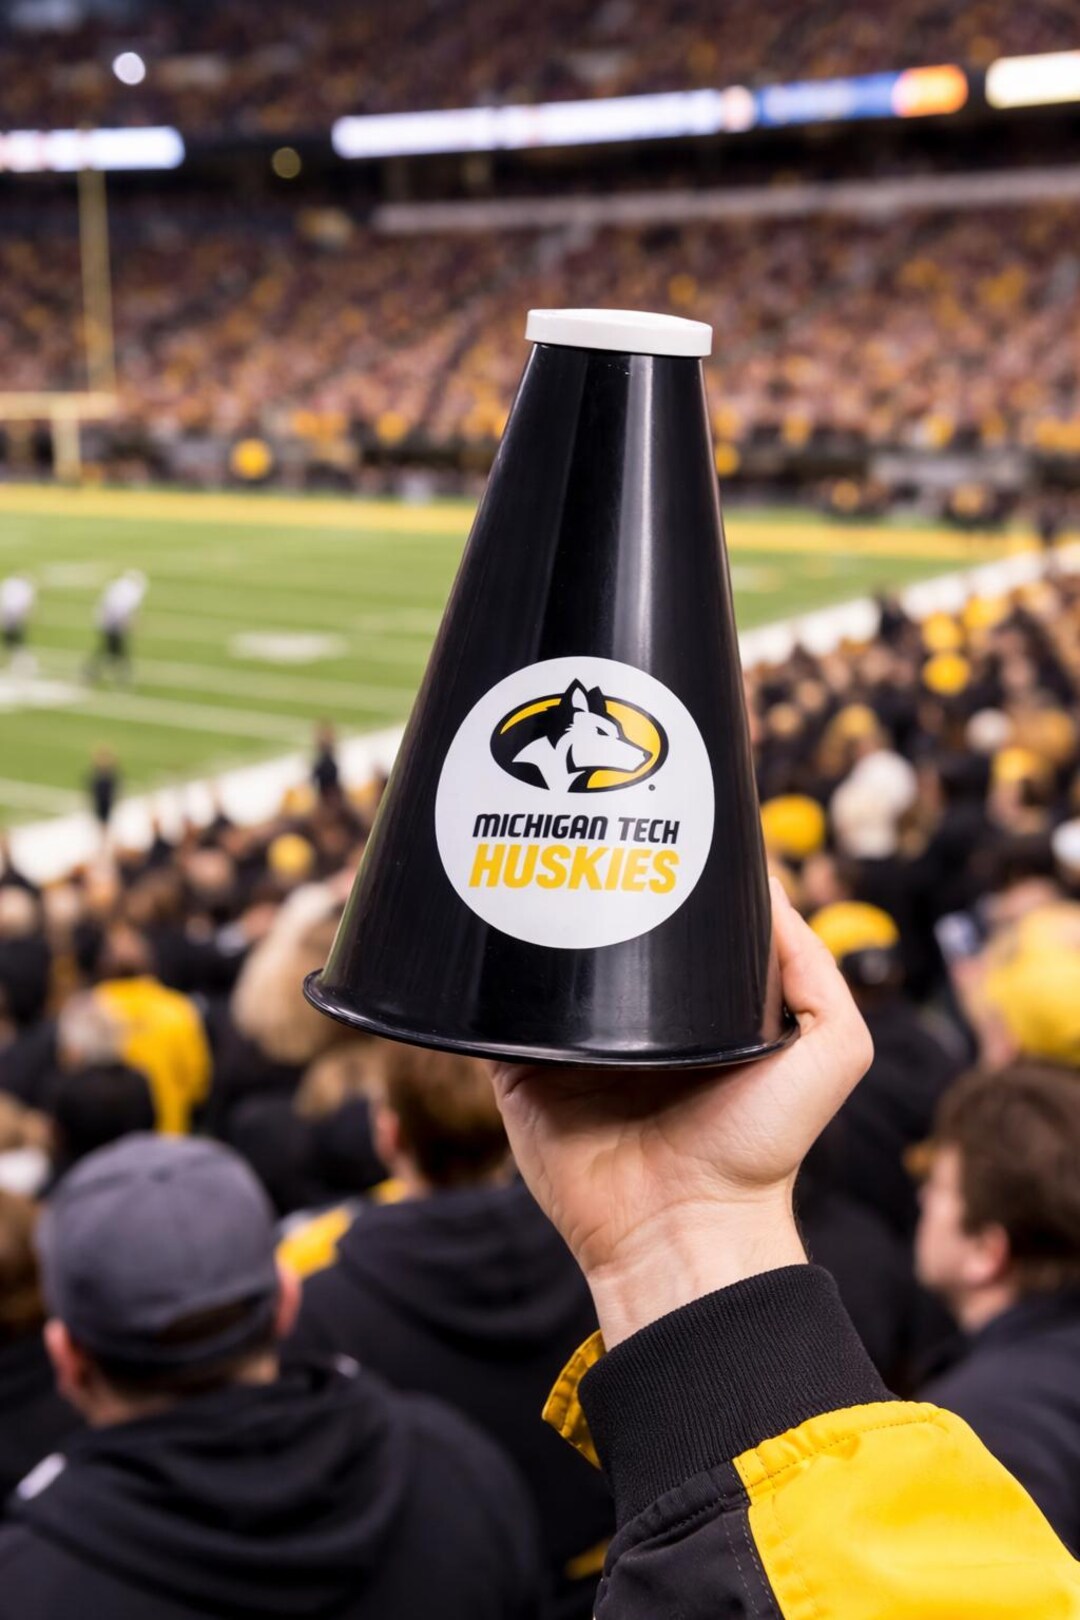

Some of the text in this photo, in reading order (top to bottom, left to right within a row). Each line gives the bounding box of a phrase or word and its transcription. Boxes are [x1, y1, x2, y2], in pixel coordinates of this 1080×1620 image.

[472, 813, 681, 845] MICHIGAN TECH
[468, 843, 681, 894] HUSKIES
